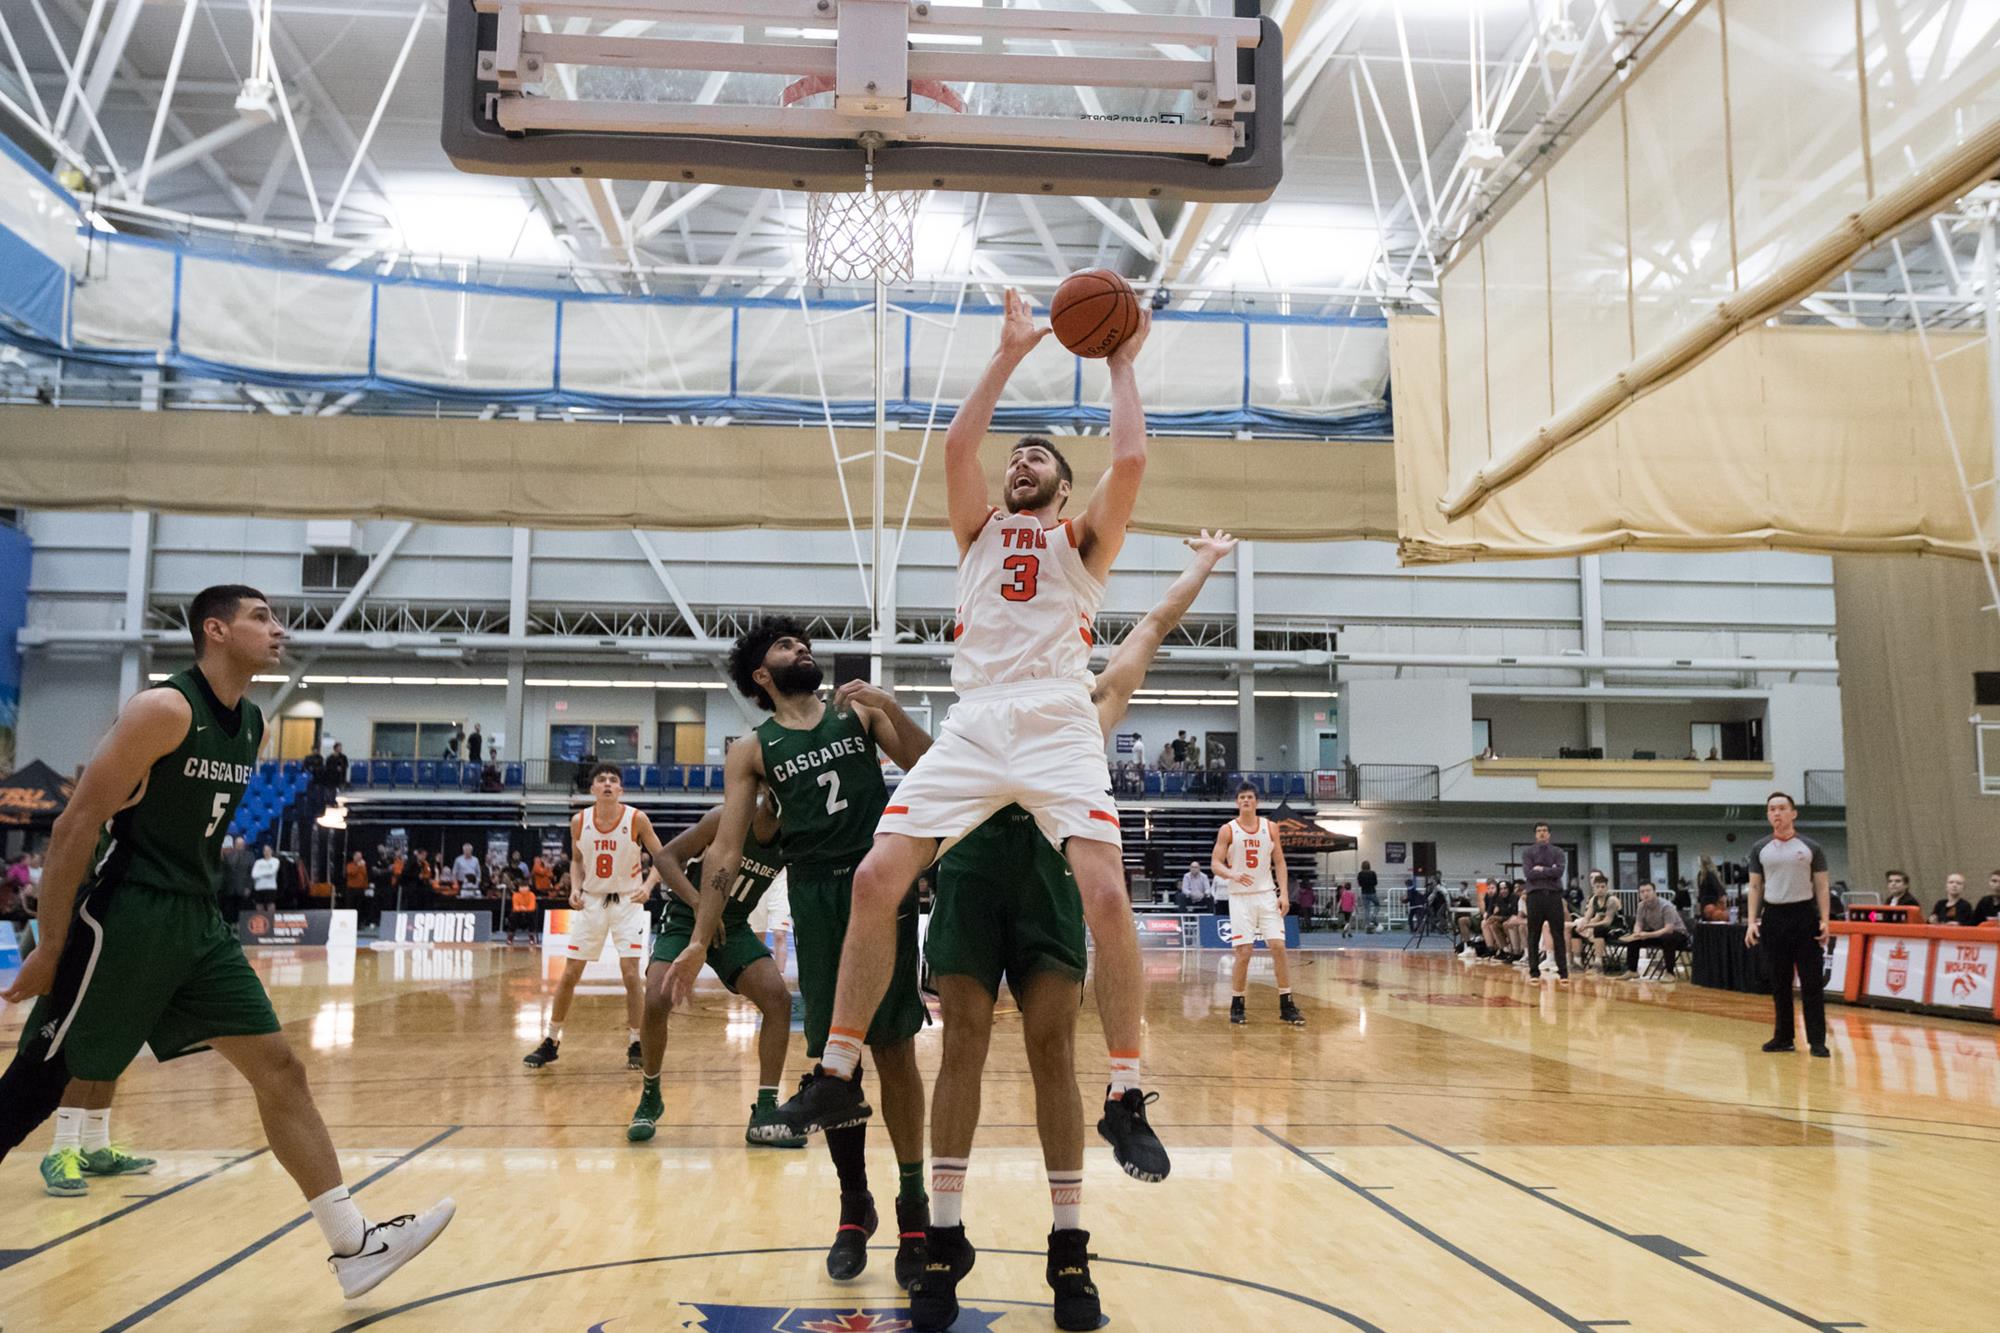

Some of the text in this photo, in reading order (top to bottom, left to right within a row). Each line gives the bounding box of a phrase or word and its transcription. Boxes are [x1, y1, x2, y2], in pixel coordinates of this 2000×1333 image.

[1001, 528, 1047, 549] TRU
[1000, 554, 1040, 602] 3
[773, 736, 866, 783] CASCADES
[816, 769, 849, 816] 2
[204, 791, 231, 838] 5
[594, 839, 617, 851] TRU
[1244, 839, 1260, 848] TRU
[596, 853, 613, 879] 8
[1245, 849, 1259, 869] 5
[730, 874, 755, 902] 11
[395, 913, 475, 942] U SPORTS
[1956, 945, 1980, 961] TRU
[1055, 1190, 1082, 1204] NIK
